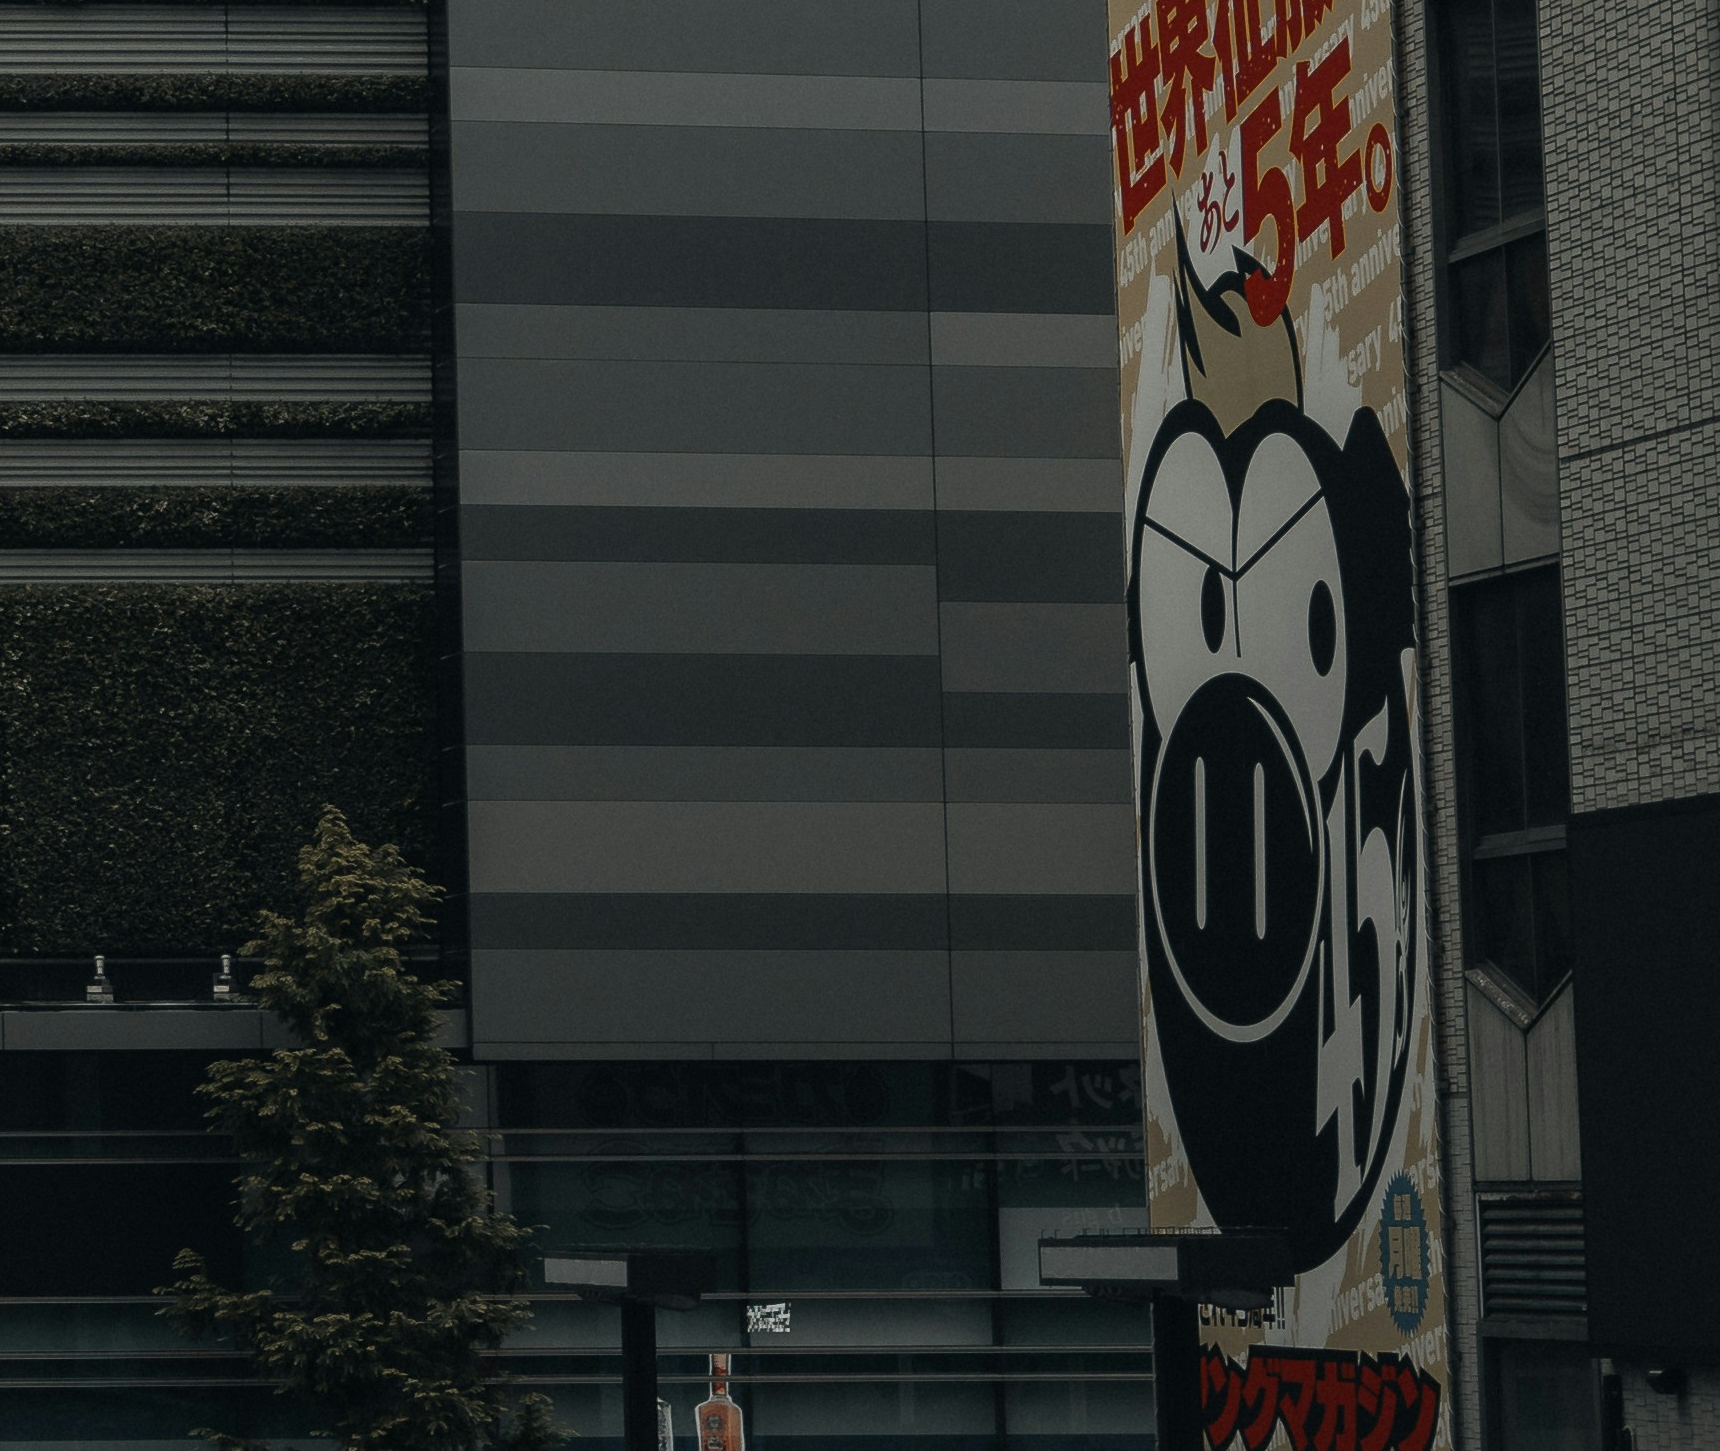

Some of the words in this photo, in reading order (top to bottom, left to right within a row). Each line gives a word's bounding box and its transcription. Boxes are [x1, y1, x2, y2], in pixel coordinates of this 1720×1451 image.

[1200, 1354, 1439, 1451] ングマガジン
